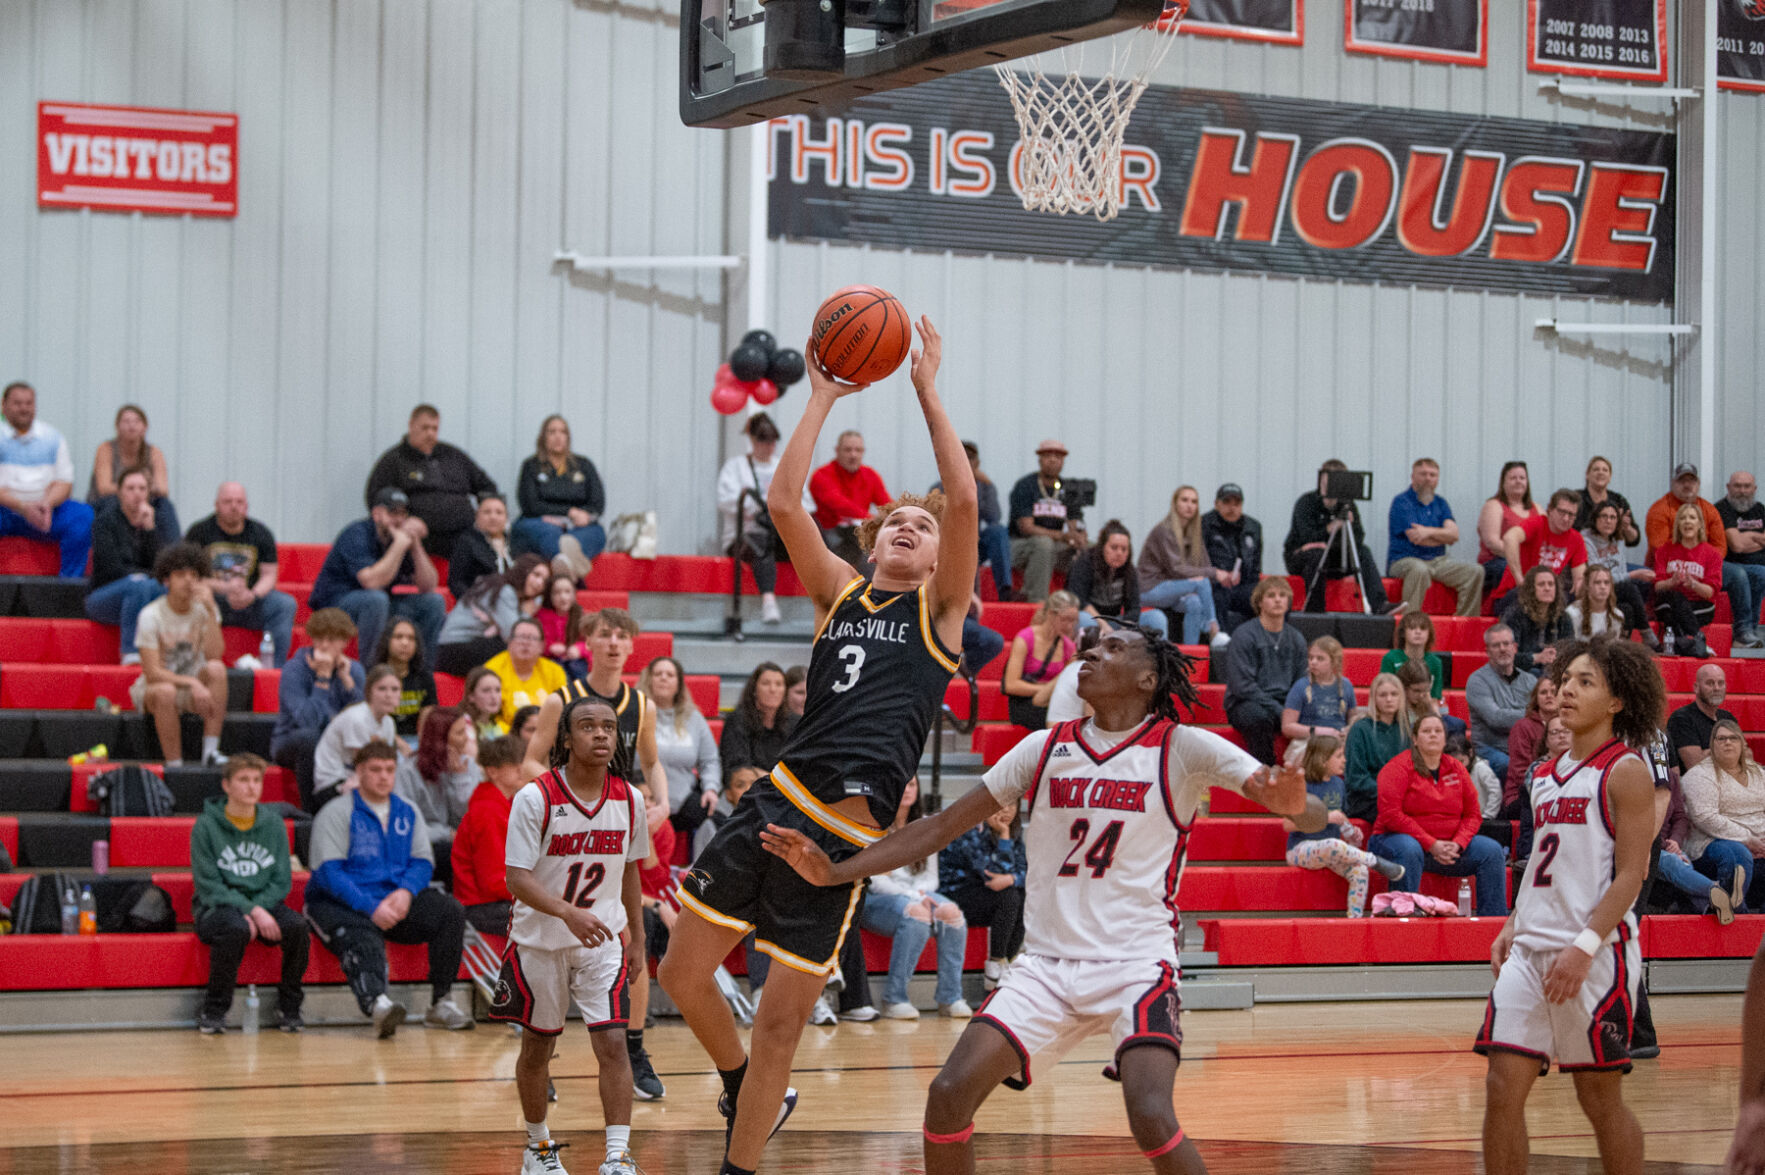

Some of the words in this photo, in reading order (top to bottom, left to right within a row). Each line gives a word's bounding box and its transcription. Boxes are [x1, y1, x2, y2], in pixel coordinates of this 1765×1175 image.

[1545, 39, 1575, 57] 2014
[1580, 44, 1613, 60] 2015
[1619, 48, 1649, 64] 2016
[1546, 19, 1575, 36] 2007
[1580, 23, 1613, 40] 2008
[1619, 27, 1649, 44] 2013
[1716, 37, 1744, 53] 2011
[44, 132, 231, 184] VISITORS
[930, 127, 996, 197] IS
[1180, 126, 1669, 273] HOUSE
[831, 645, 866, 693] 3
[1089, 778, 1153, 813] CREEK
[1057, 818, 1125, 879] 24
[1533, 833, 1560, 887] 2
[562, 861, 606, 909] 12
